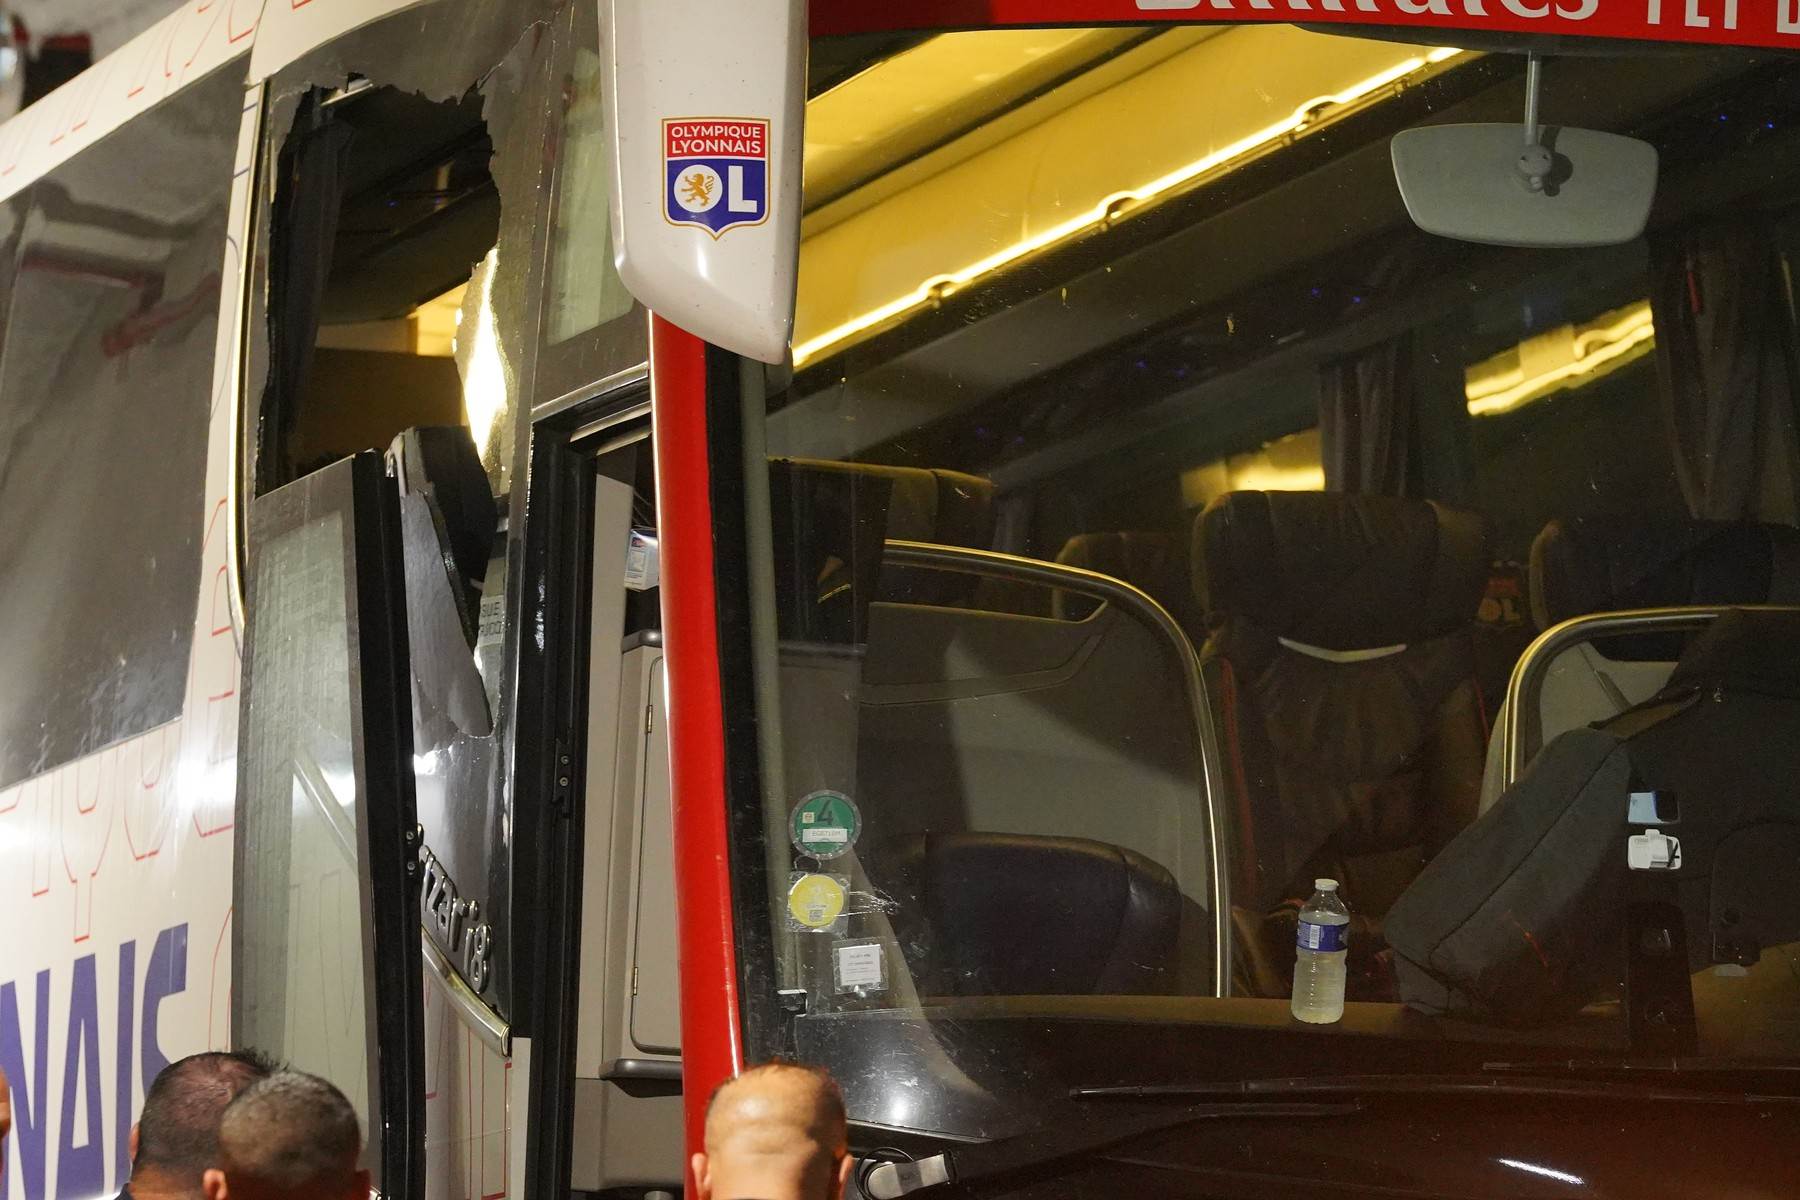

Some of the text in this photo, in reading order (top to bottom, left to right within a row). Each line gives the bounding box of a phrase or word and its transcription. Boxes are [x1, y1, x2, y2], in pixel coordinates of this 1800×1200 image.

[671, 125, 761, 139] OLYMPIQUE
[671, 139, 761, 154] LYONNAIS
[817, 798, 834, 827] 4
